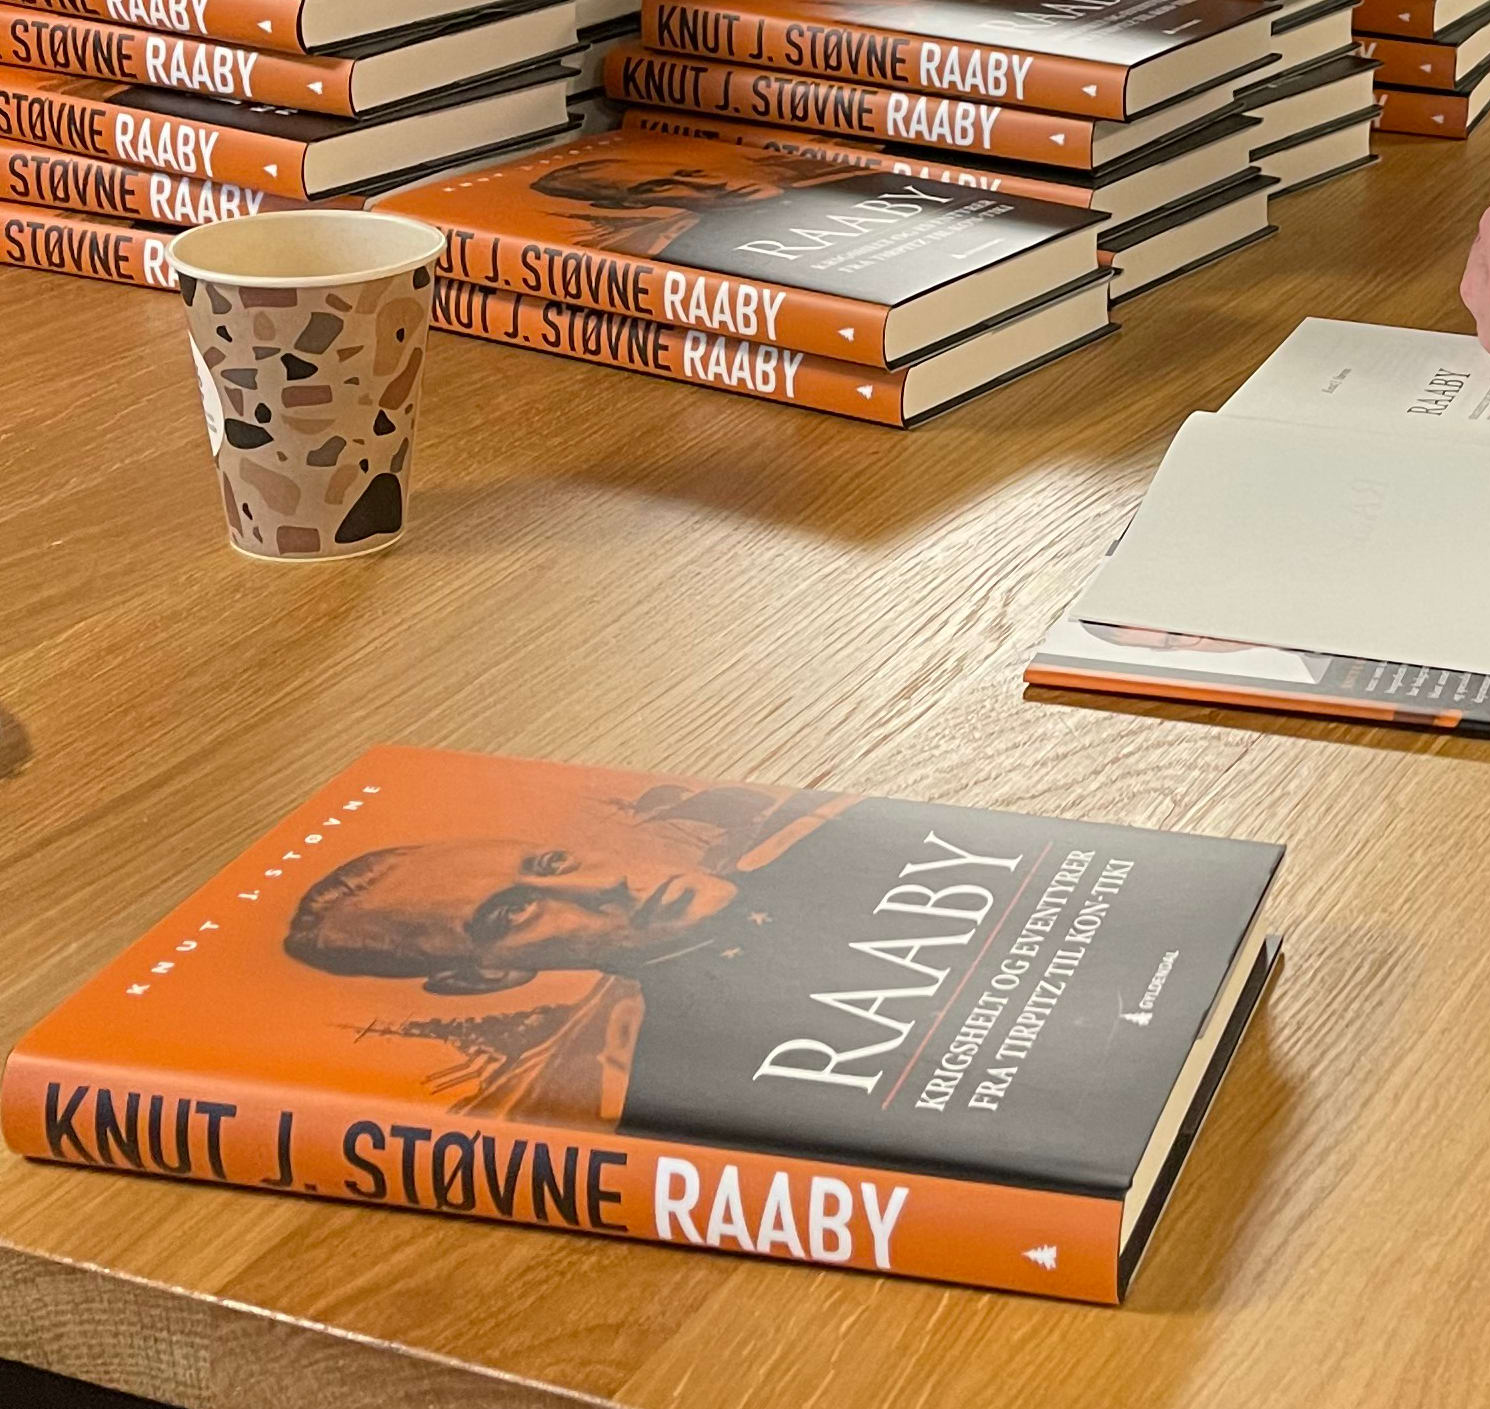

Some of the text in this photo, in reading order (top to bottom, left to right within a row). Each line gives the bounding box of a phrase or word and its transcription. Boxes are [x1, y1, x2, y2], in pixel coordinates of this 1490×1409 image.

[11, 19, 259, 97] STØVNE RAABY
[657, 4, 1033, 100] KNUT J. STØVNE RAABY
[0, 92, 219, 177] STØVNE RAABY
[622, 57, 707, 107] KNUT
[715, 71, 741, 114] J.
[752, 75, 876, 132] STØVNE
[887, 92, 1001, 150] RAABY
[9, 153, 264, 224] STØVNE RAABY
[737, 184, 953, 261] RAABY
[5, 219, 135, 280] STØVNE
[485, 238, 511, 286] J.
[521, 245, 653, 316] STØVNE
[663, 271, 786, 342] RAABY
[504, 293, 530, 341] J.
[542, 300, 671, 373] STØVNE
[682, 330, 804, 399] RAABY
[1407, 367, 1471, 416] RAABY
[126, 921, 219, 995] KNUT
[238, 890, 260, 900] J.
[752, 830, 1023, 1095] RAABY
[915, 849, 1096, 1112] KRIGSHELT OG EVENTYRER
[968, 858, 1136, 1112] FRA TIRPITZ TIL KON-TIKI
[1138, 949, 1180, 1011] GYLDENDAL
[45, 1081, 911, 1270] KNUT J. STØVNE RAABY
